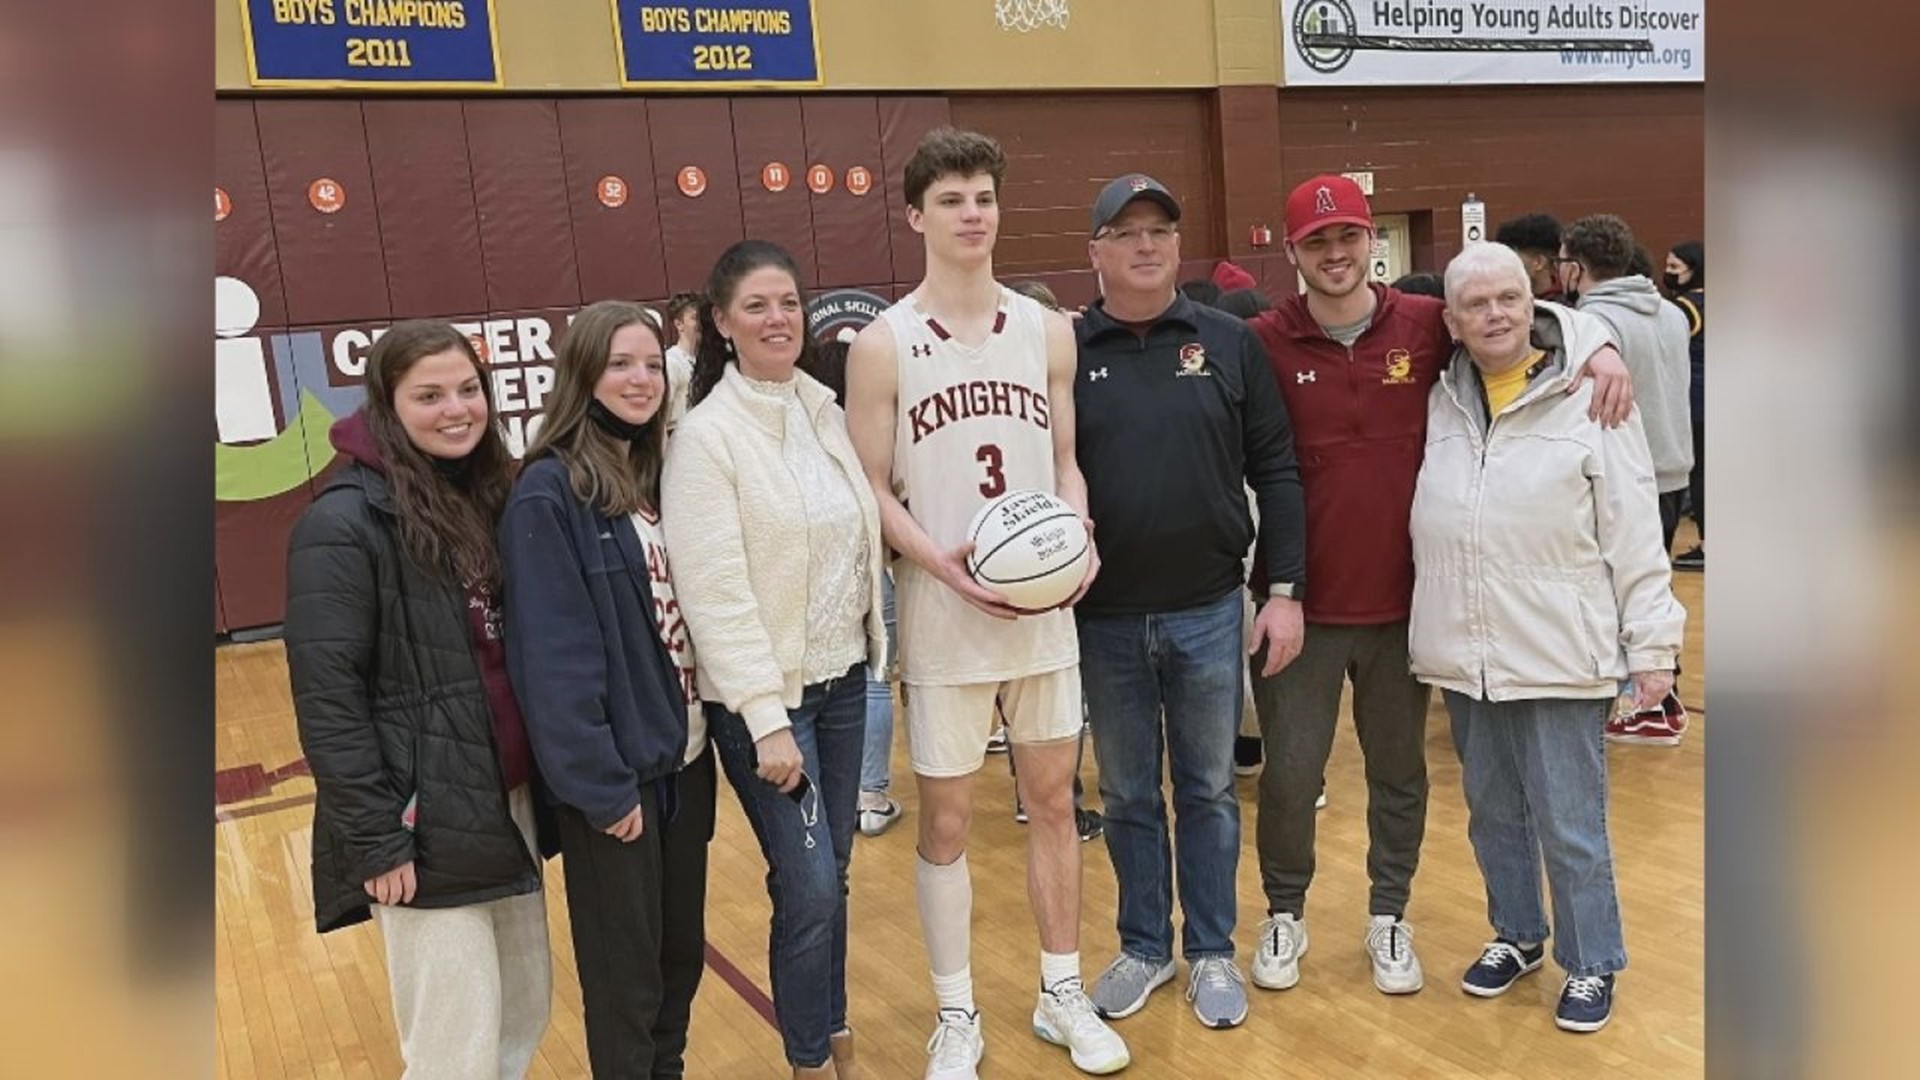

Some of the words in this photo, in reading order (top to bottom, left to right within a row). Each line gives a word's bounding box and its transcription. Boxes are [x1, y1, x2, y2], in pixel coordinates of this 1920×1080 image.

[273, 0, 336, 25] BOYS
[345, 0, 466, 29] CHAMPIONS
[641, 7, 691, 33] BOYS
[695, 8, 792, 35] CHAMPIONS
[1373, 0, 1464, 34] Helping
[1472, 4, 1541, 34] Young
[1547, 2, 1613, 30] Adults
[1619, 5, 1700, 31] Discover
[346, 38, 412, 67] 2011
[693, 45, 752, 70] 2012
[318, 184, 336, 201] 42
[686, 171, 698, 185] 5
[1315, 184, 1337, 215] A
[844, 300, 883, 317] SKILL
[908, 380, 1050, 445] KNIGHTS
[975, 444, 1007, 499] 3
